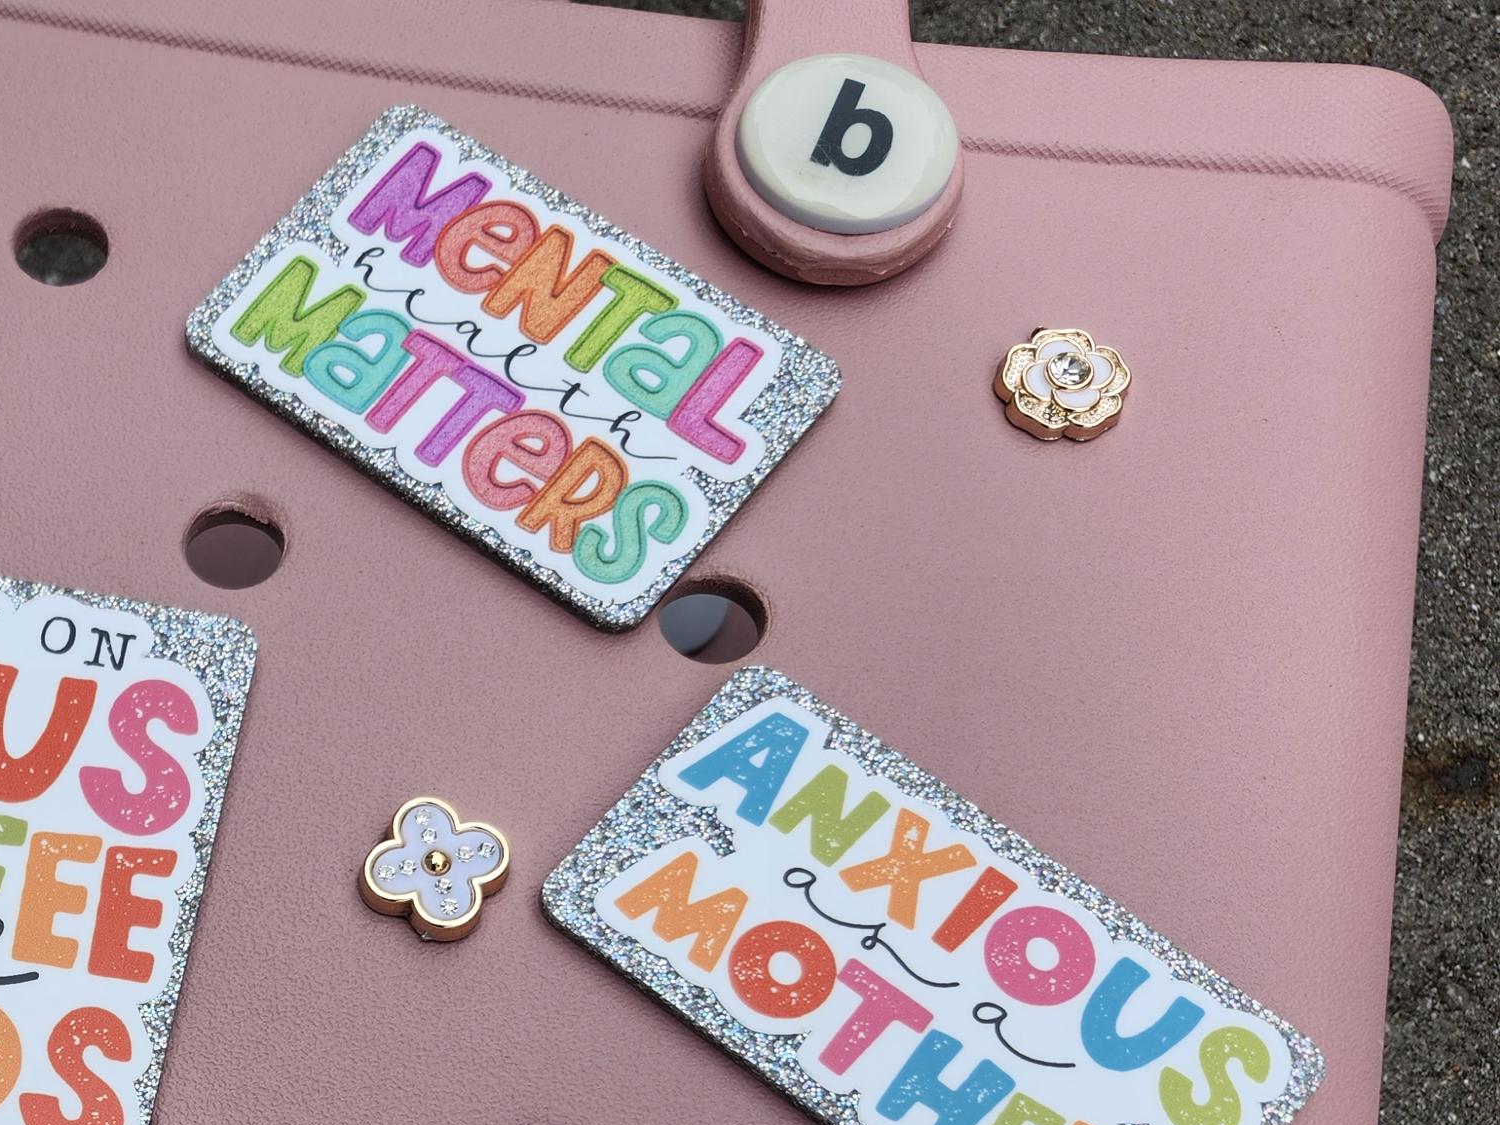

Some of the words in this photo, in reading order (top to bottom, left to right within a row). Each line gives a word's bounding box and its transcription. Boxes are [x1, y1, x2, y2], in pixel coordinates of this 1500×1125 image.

[810, 78, 894, 177] b
[354, 246, 678, 461] health
[40, 616, 137, 671] ON
[783, 866, 959, 988] as
[972, 1001, 1076, 1069] a
